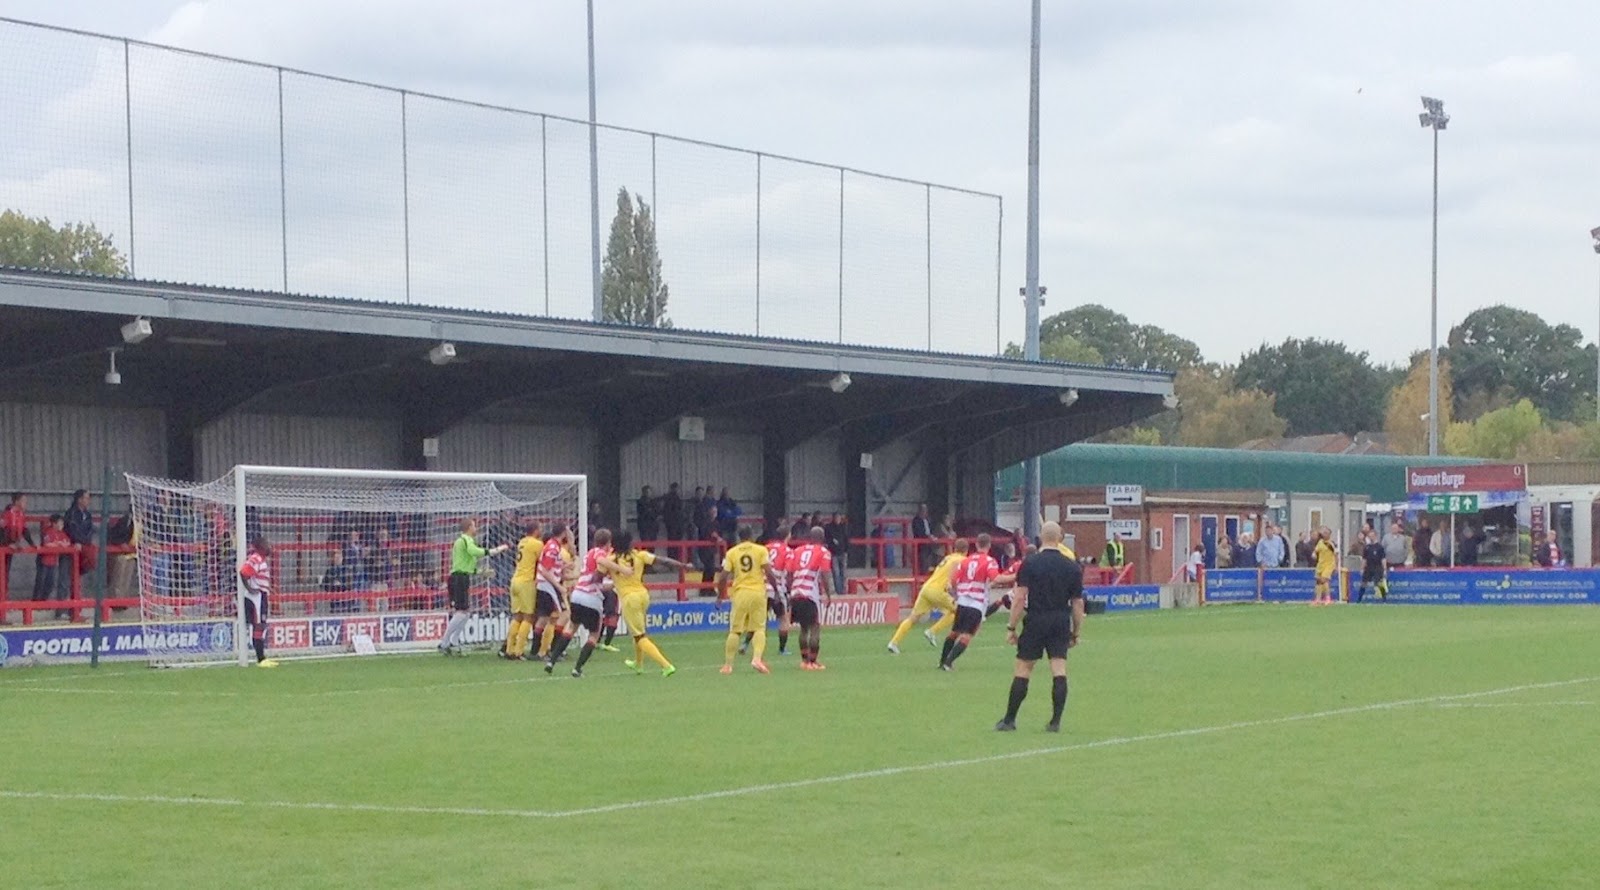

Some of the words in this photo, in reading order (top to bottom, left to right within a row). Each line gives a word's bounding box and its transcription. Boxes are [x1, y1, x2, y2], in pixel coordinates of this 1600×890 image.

[1411, 471, 1441, 487] Gourmet
[1441, 470, 1466, 489] Burger
[1108, 486, 1122, 494] TEA
[740, 554, 753, 573] 9
[800, 549, 812, 568] 9
[646, 613, 663, 628] EM
[674, 611, 704, 626] FLOW
[708, 611, 730, 625] CHE
[820, 601, 887, 626] YRED.CO.UK
[273, 624, 308, 645] BET
[315, 621, 341, 645] sky
[346, 622, 378, 641] BET
[386, 619, 410, 641] sky
[415, 619, 445, 638] BET
[22, 636, 111, 656] FOOTBAL
[115, 631, 200, 651] MANAGER
